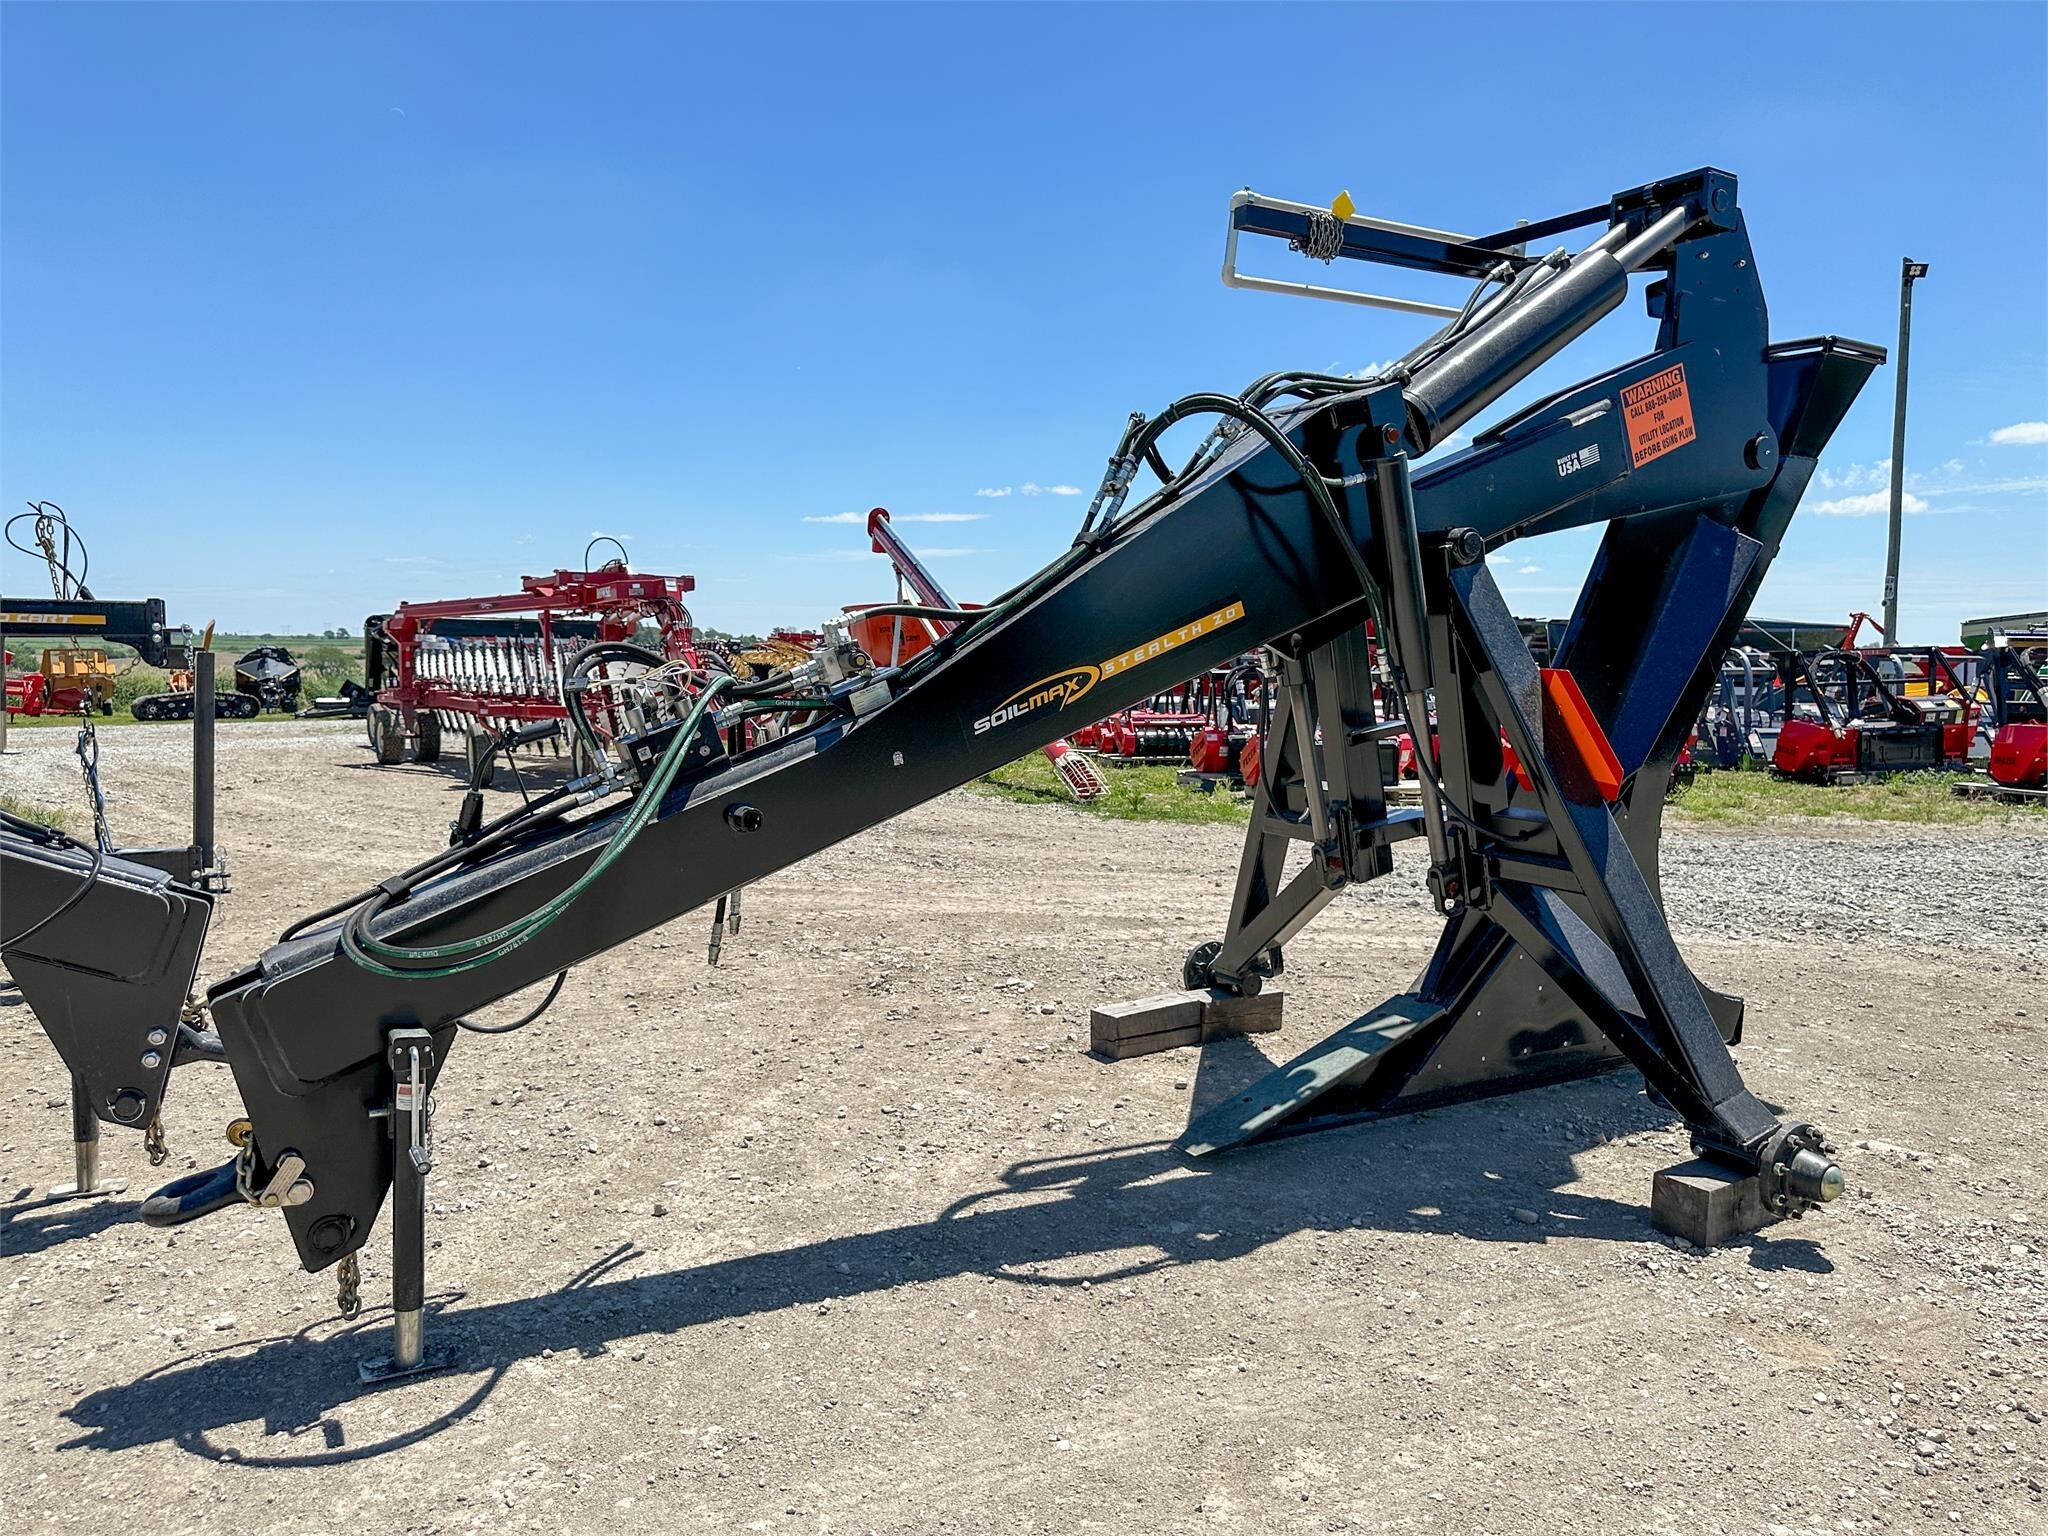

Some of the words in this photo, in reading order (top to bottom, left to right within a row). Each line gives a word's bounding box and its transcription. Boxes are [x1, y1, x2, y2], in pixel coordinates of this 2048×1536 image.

[1625, 369, 1682, 405] WARNING
[1630, 404, 1645, 419] CALL
[1654, 410, 1665, 423] FOR
[1639, 428, 1659, 446] UTILITY
[1659, 416, 1684, 437] LOCATION
[1635, 442, 1661, 463] BEFORE
[1662, 434, 1679, 450] USING
[1679, 426, 1694, 443] PLOW
[1558, 459, 1581, 477] USA
[16, 614, 71, 624] CART
[1104, 623, 1203, 676] STEALTH
[1213, 607, 1238, 627] ZD
